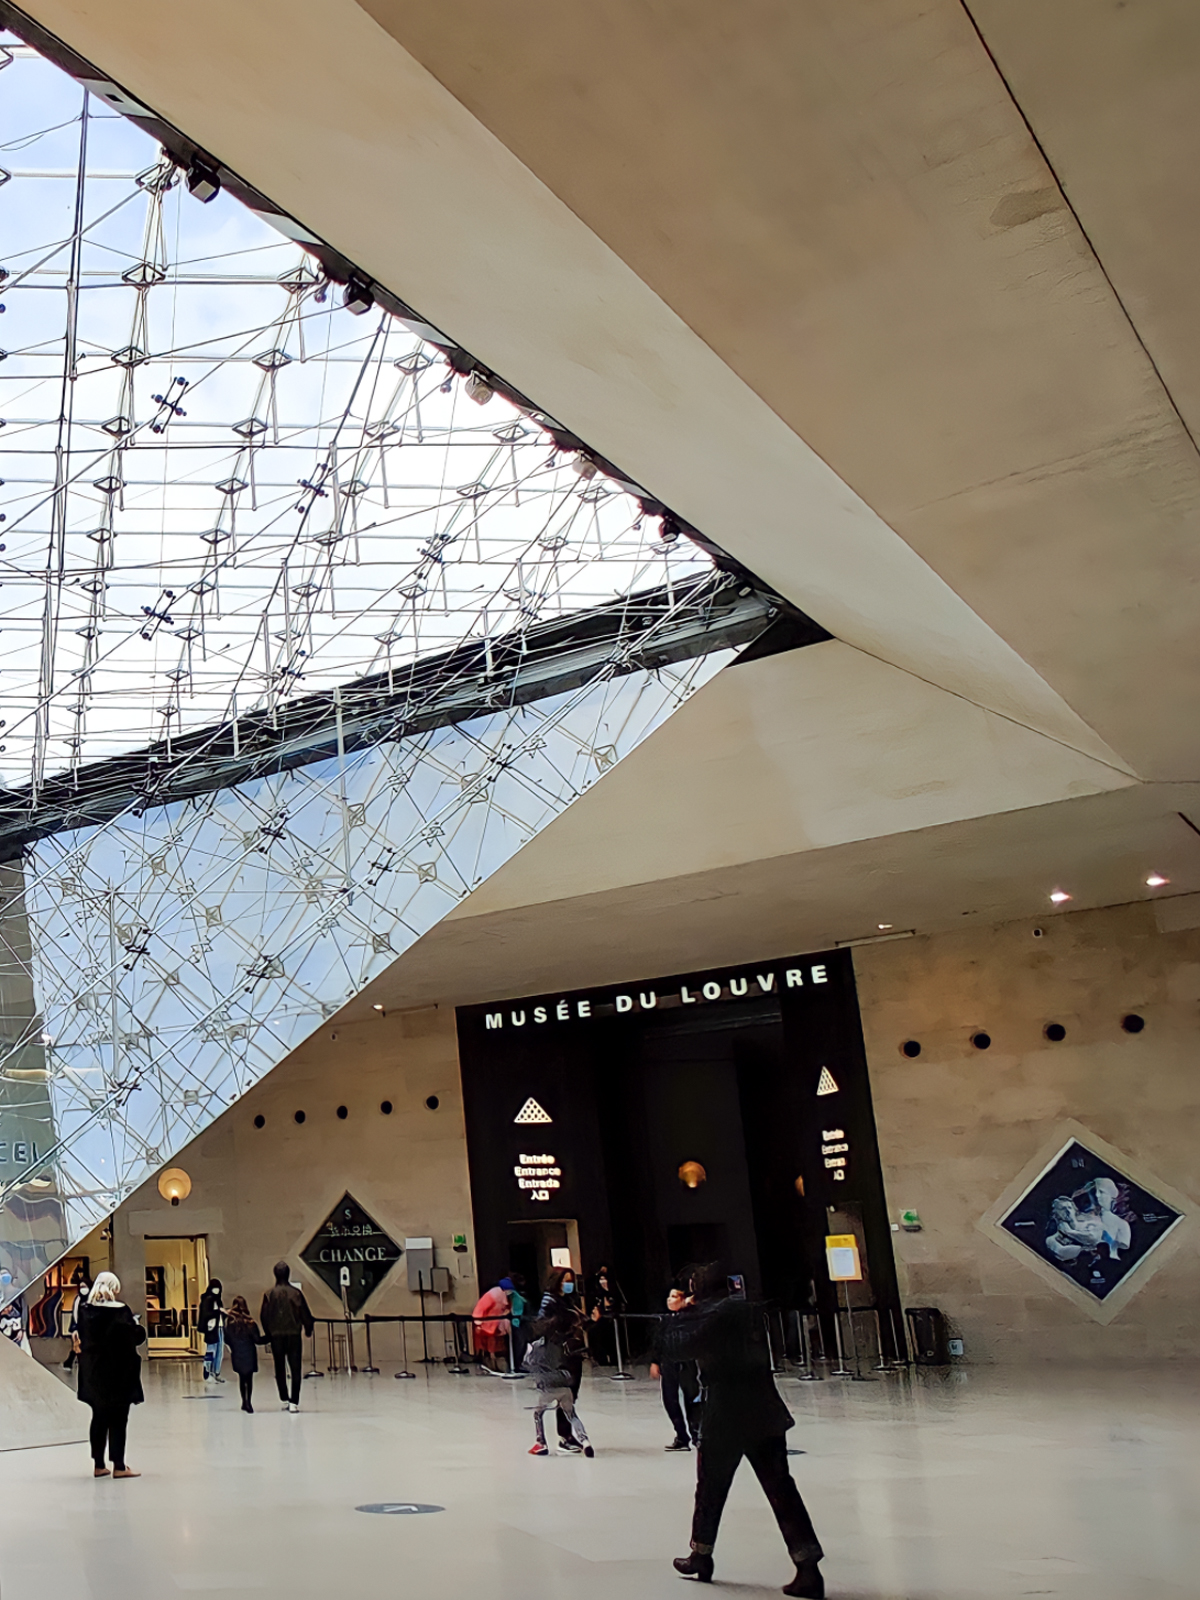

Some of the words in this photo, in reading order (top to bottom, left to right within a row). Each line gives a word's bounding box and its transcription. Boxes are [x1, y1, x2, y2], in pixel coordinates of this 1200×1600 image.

[485, 1000, 592, 1030] MUSÉE
[615, 992, 657, 1013] DU
[680, 965, 828, 1004] LOUVRE
[514, 1166, 562, 1177] Entrance
[518, 1178, 560, 1189] Entrada
[319, 1247, 388, 1263] CHANGE
